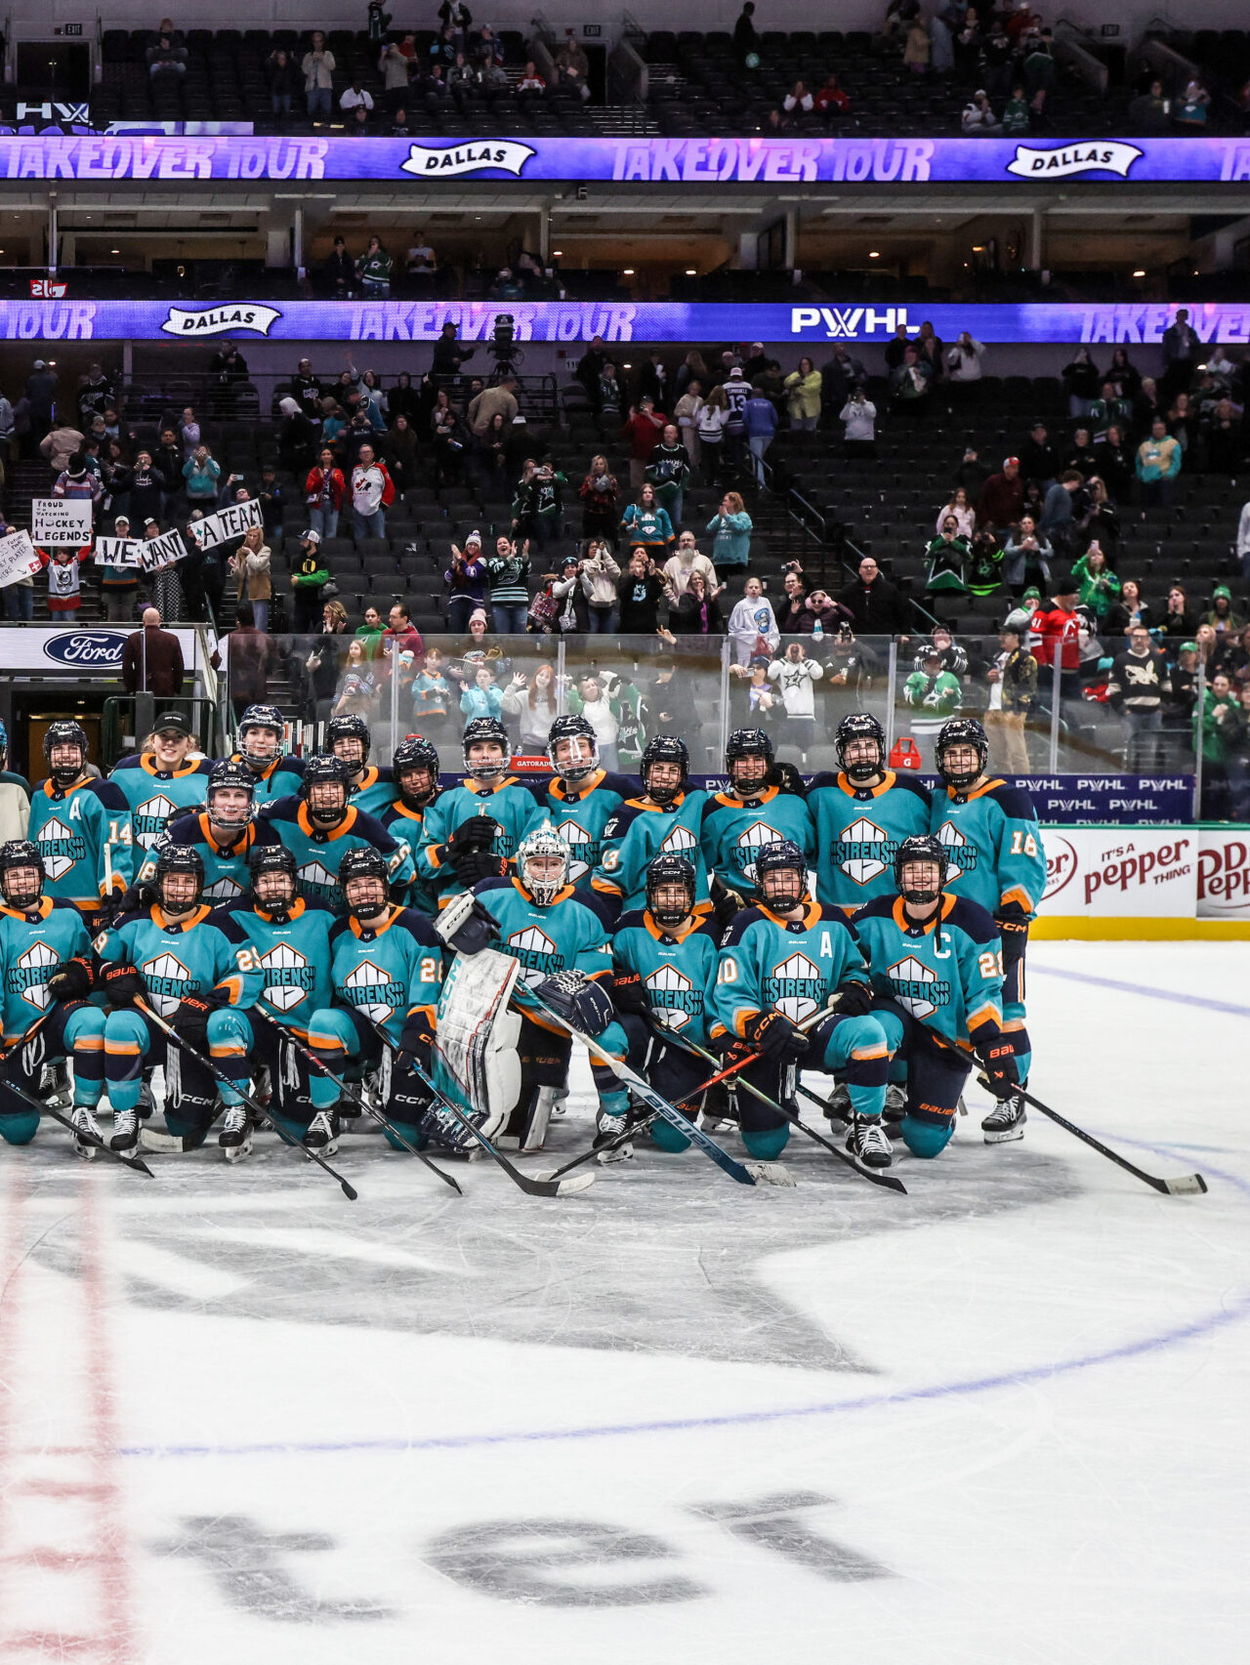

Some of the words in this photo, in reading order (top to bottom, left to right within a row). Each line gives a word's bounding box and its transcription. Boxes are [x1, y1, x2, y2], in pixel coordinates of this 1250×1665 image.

[6, 136, 216, 179] TAKEOVER
[226, 137, 330, 179] TOUR
[424, 147, 508, 170] DALLAS
[611, 137, 820, 181] TAKEOVER
[831, 138, 935, 181] TOUR
[1030, 148, 1114, 172] DALLAS
[4, 301, 97, 339] TOUR
[182, 309, 257, 331] DALLAS
[547, 302, 637, 341] TOUR
[790, 306, 921, 338] PWHL
[35, 531, 90, 542] LEGENDS
[203, 520, 219, 547] A
[220, 501, 264, 535] TEAM
[102, 540, 138, 565] WE
[63, 635, 122, 662] Ford
[516, 760, 552, 768] GATORAD
[1015, 778, 1065, 791] PWHL
[1077, 778, 1125, 791] PWHL
[1139, 778, 1187, 791] PWHL
[69, 797, 82, 820] A
[1048, 799, 1096, 812] PWHL
[1109, 799, 1157, 812] PWHL
[109, 821, 132, 846] 14
[132, 815, 164, 835] SIRE
[836, 840, 891, 862] SIRENS
[1009, 830, 1038, 857] 16
[1101, 845, 1125, 862] IT'S
[1125, 843, 1136, 853] A
[1084, 838, 1190, 905] pepper
[1152, 864, 1191, 886] THING
[446, 901, 471, 930] CCM
[820, 931, 833, 958] A
[933, 932, 951, 959] C
[15, 963, 58, 990] SIREN
[105, 965, 137, 981] BAUE
[265, 966, 311, 992] IRENS
[420, 957, 443, 984] 2
[614, 972, 642, 987] BAUE
[342, 981, 397, 1008] SIRENS
[436, 957, 462, 1021] CCM
[650, 987, 695, 1016] IRENS
[768, 976, 824, 1004] SIRENS
[893, 980, 942, 1005] IRENS
[180, 996, 209, 1012] UER
[753, 1011, 781, 1041] CCM
[989, 1044, 1015, 1059] BAU
[180, 1093, 215, 1107] CCM
[394, 1093, 429, 1104] CCM
[643, 1093, 721, 1157] BAUER
